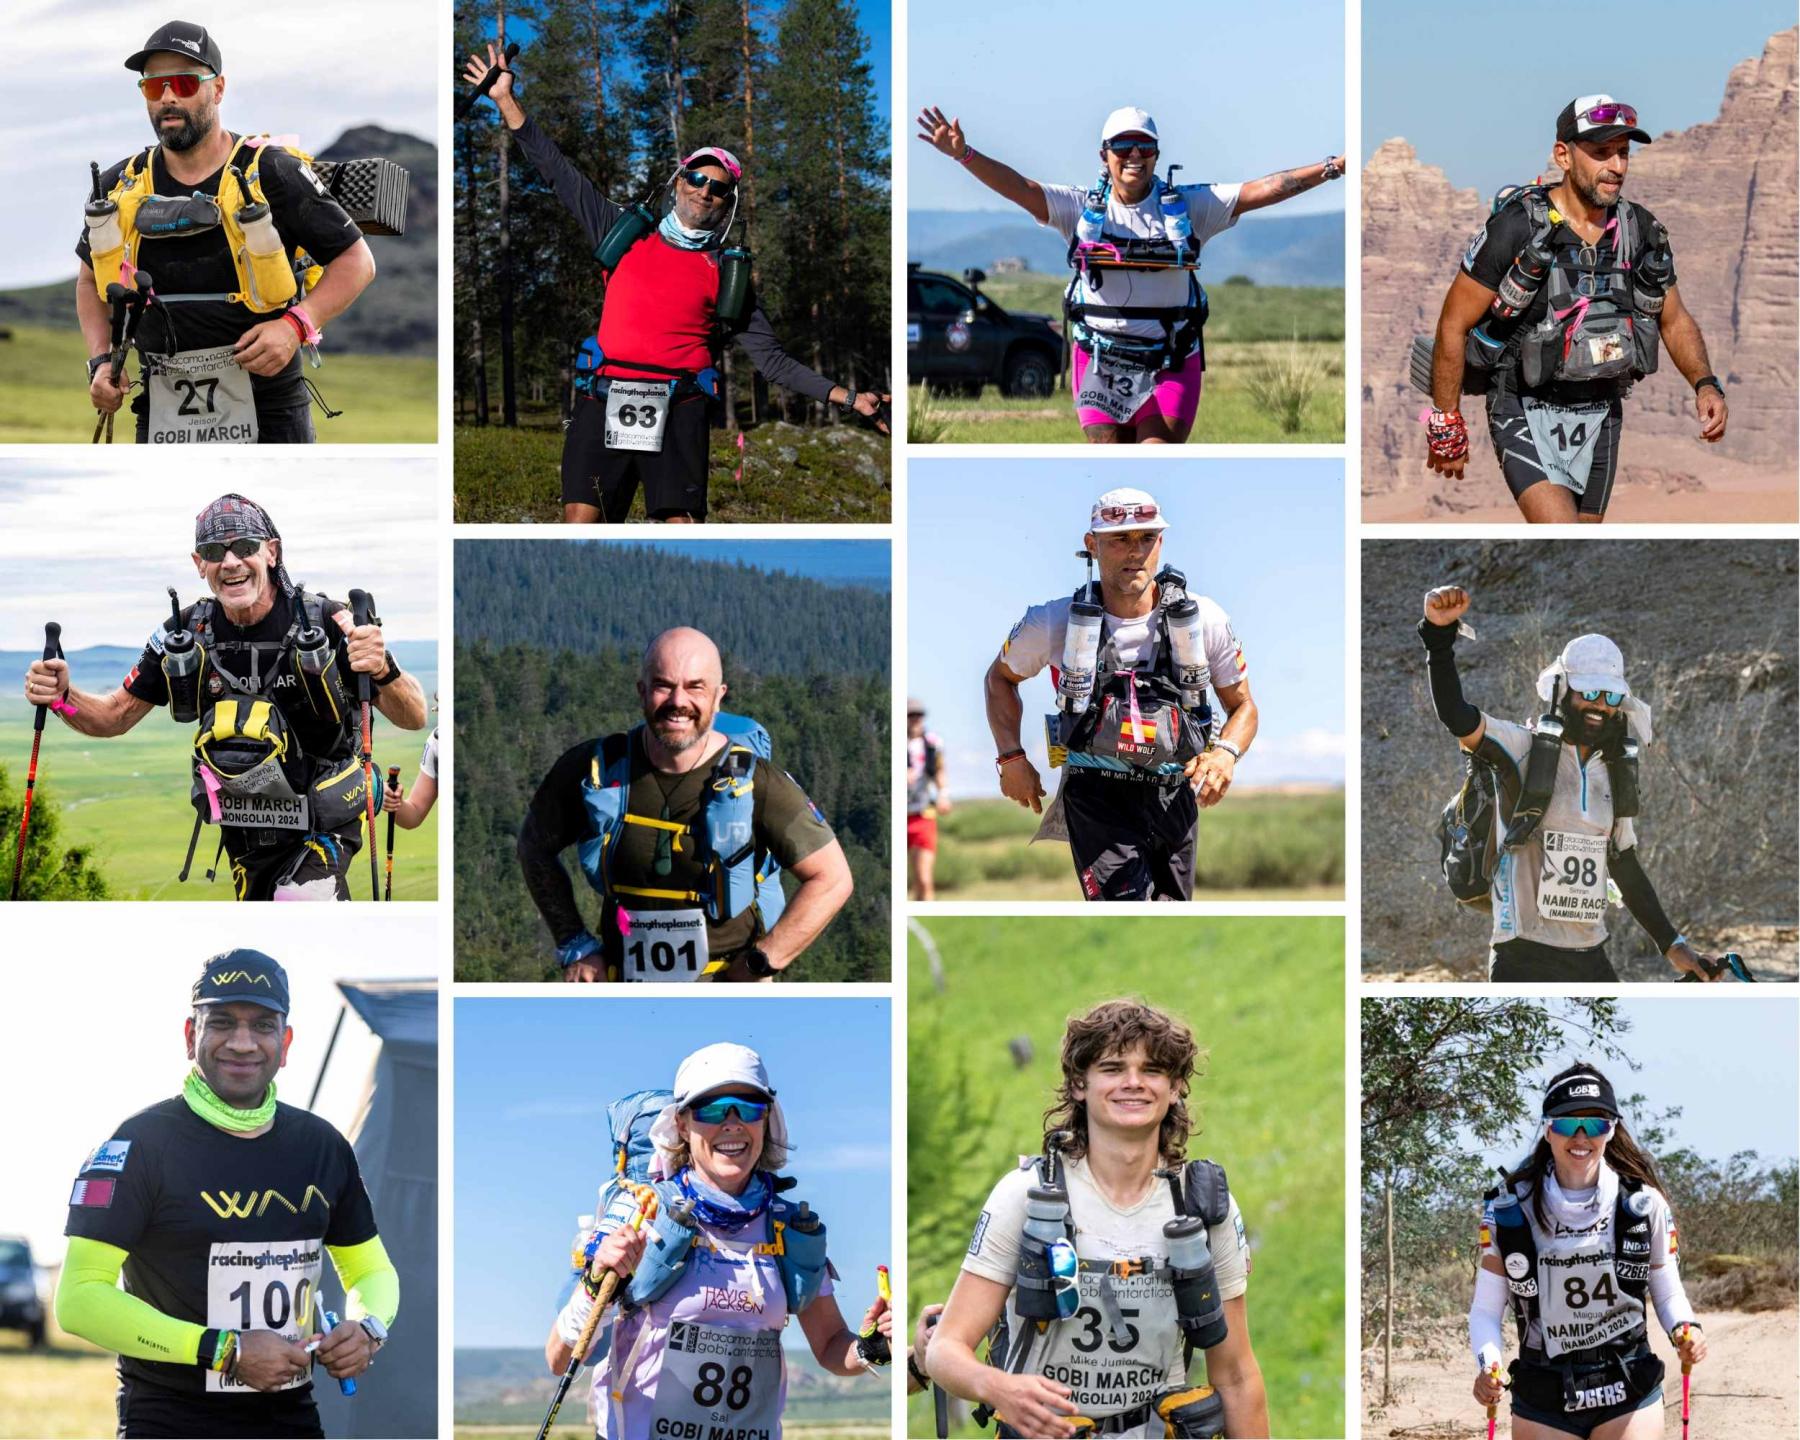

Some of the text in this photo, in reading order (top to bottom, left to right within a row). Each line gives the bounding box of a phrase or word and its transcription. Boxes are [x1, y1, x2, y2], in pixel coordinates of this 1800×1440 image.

[1103, 373, 1133, 397] 13
[174, 377, 219, 416] 27
[1080, 390, 1132, 415] GOBI MAR
[618, 404, 657, 428] 63
[154, 423, 252, 444] GOBI MARCH
[1549, 422, 1587, 451] 14
[1117, 741, 1156, 755] WILD WOLF
[252, 798, 302, 813] MARCH
[221, 812, 299, 825] MONGOLIA) 2024
[1563, 855, 1598, 887] 98
[1542, 894, 1606, 910] NAMIB RACE
[1549, 908, 1599, 920] (NAMIBIA) 2024
[629, 918, 703, 932] acingtheplanet.
[628, 940, 698, 972] 101
[1555, 1217, 1608, 1235] LXS
[1617, 1262, 1649, 1279] 226ER
[705, 1285, 748, 1302] HAVIG
[1563, 1272, 1618, 1309] 84
[229, 1277, 311, 1330] 100
[702, 1298, 764, 1315] JACKSON
[699, 1329, 780, 1346] atacama.nam
[1071, 1306, 1140, 1353] 35
[1561, 1328, 1607, 1352] (NAMIBIA)
[1608, 1316, 1630, 1334] 2024
[697, 1342, 781, 1358] gobi.antarctic
[1070, 1355, 1138, 1368] Mike Junior
[1043, 1364, 1163, 1389] GOBI MARCH
[693, 1362, 753, 1411] 88
[1068, 1391, 1127, 1407] NGOLIA)
[710, 1412, 729, 1423] Sal
[656, 1418, 770, 1440] GOBI MARCH
